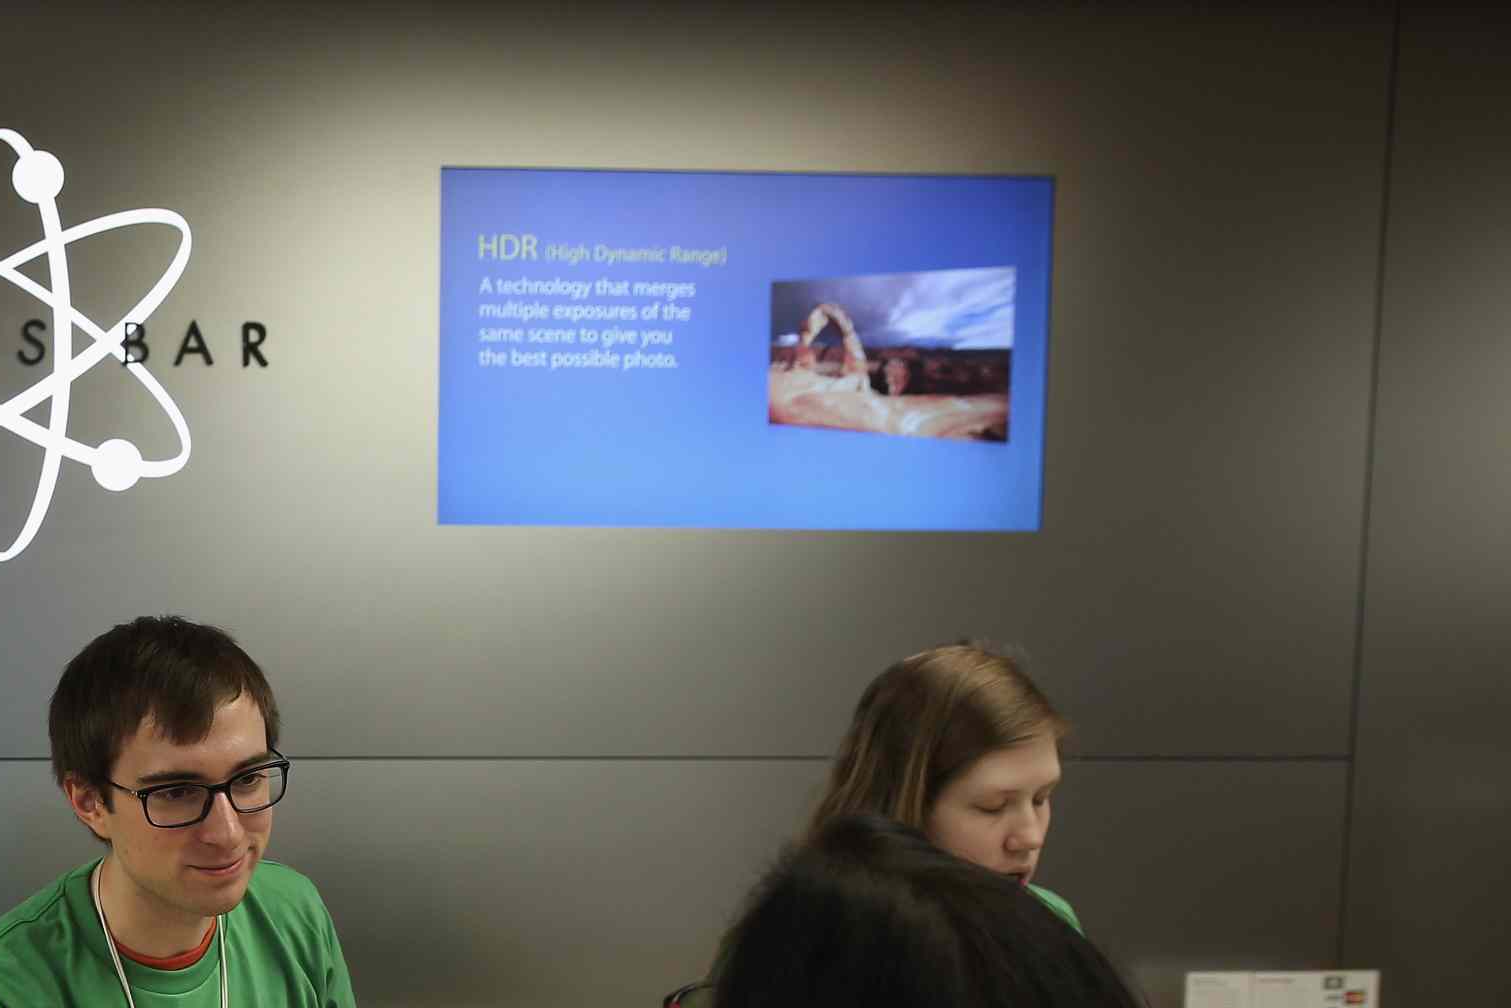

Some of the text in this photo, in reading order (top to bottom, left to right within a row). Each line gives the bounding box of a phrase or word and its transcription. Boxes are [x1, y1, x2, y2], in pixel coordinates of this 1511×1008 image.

[477, 233, 728, 267] HDR (High Dynamic Range)
[479, 276, 696, 300] A technology that merges
[479, 301, 691, 322] multiple exposures of the
[122, 319, 269, 368] BAR
[479, 325, 673, 347] same scene to give you
[479, 349, 678, 371] the best possible photo.
